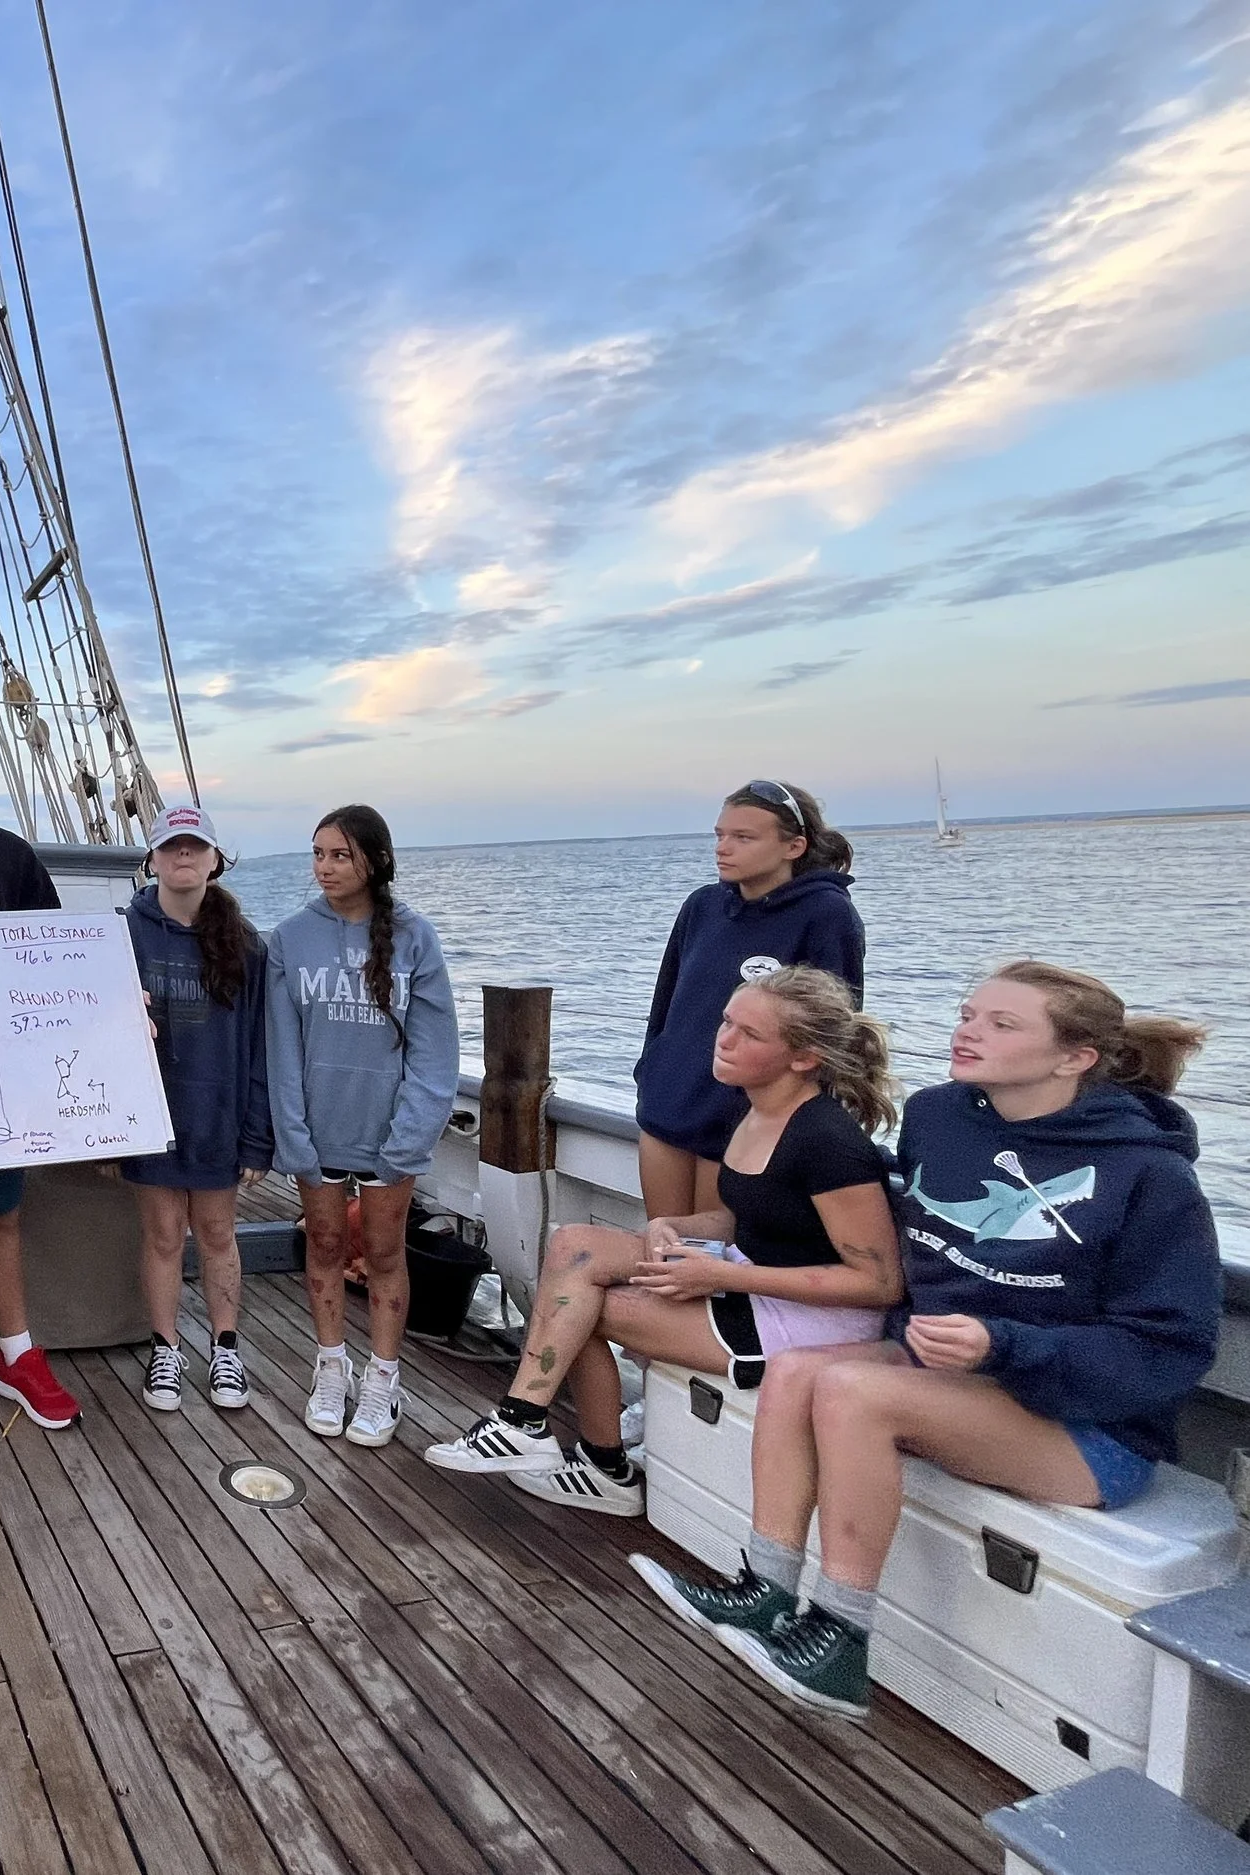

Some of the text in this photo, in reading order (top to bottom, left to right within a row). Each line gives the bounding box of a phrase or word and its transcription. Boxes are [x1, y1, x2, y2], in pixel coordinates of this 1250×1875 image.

[40, 925, 106, 939] DISTANCE
[62, 951, 87, 961] nm
[298, 966, 411, 1011] MAIE
[327, 1003, 386, 1026] BLACK BEARS
[45, 1018, 72, 1028] nm
[58, 1102, 111, 1118] HERDSMAN
[85, 1134, 96, 1148] C
[984, 1267, 1066, 1288] LACROSSE
